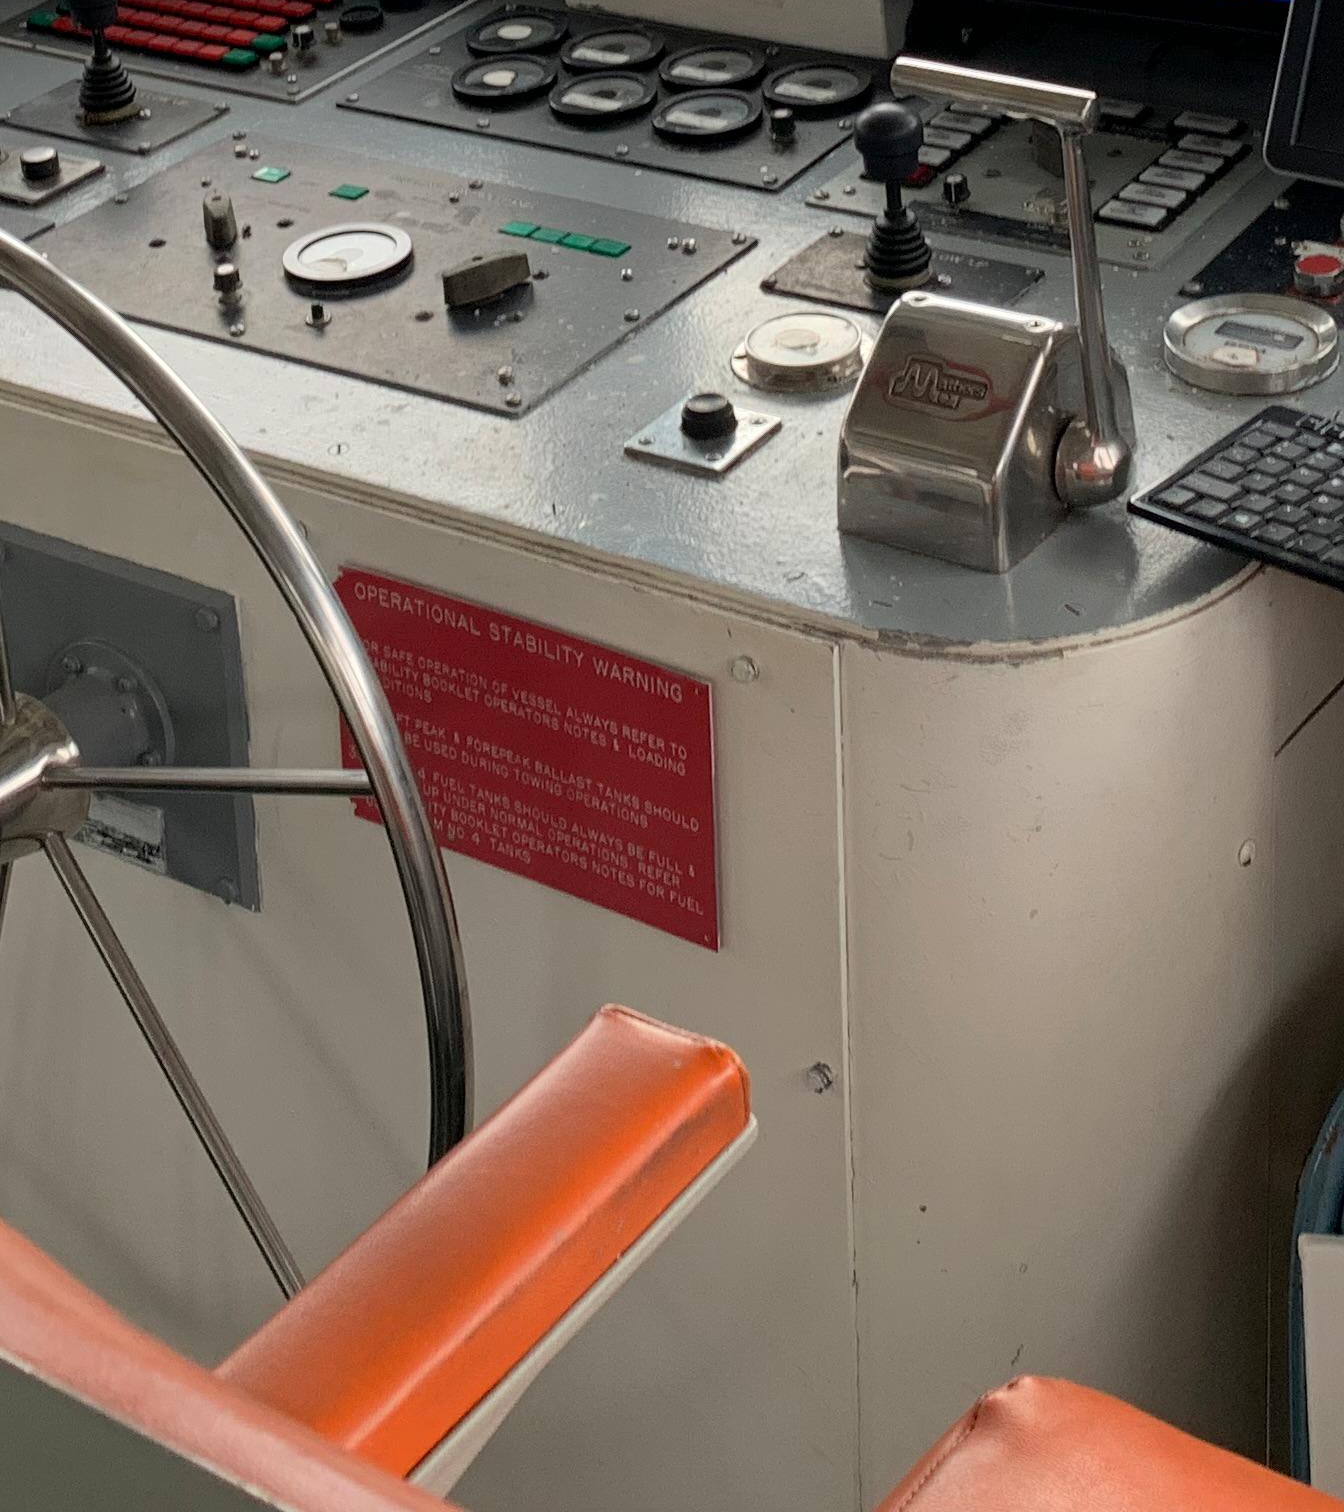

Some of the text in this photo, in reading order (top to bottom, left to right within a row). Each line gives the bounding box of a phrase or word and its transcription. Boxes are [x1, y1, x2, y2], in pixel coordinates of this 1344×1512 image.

[353, 579, 683, 705] OPERATIONAL STABILITY WARNING
[382, 644, 414, 667] SAFE
[416, 654, 488, 692] OPERATION
[492, 679, 507, 698] OF
[510, 686, 561, 717] VESSEL
[565, 705, 618, 736] ALWAYS
[621, 725, 666, 754] REFER
[668, 741, 687, 762] TO
[422, 671, 480, 705] BOOKLET
[483, 691, 559, 732] OPERATORS
[563, 719, 607, 748] NOTES
[627, 743, 686, 778] LOADING
[403, 729, 648, 830] BE USED DURING TOWING OPERATIONS
[414, 717, 446, 741] PEAK
[465, 735, 531, 771] FOREPEAK
[534, 759, 593, 793] BALLAST
[596, 781, 640, 811] TANKS
[643, 799, 699, 834] SHOULD
[431, 770, 465, 796] FUEL
[468, 783, 510, 811] TANKS
[513, 799, 568, 833] SHOULD
[570, 821, 623, 853] ALWAYS
[626, 841, 644, 861] BE
[647, 850, 682, 876] FULL
[422, 781, 440, 800] UP
[442, 788, 485, 818] UNDER
[488, 805, 543, 838] NORMAL
[637, 860, 681, 890] REFER
[450, 806, 508, 842] BOOKLET
[511, 829, 588, 872] OPERATORS
[590, 859, 636, 890] NOTES
[638, 878, 665, 901] FOR
[669, 890, 703, 917] FUEL
[489, 836, 531, 866] TANKS
